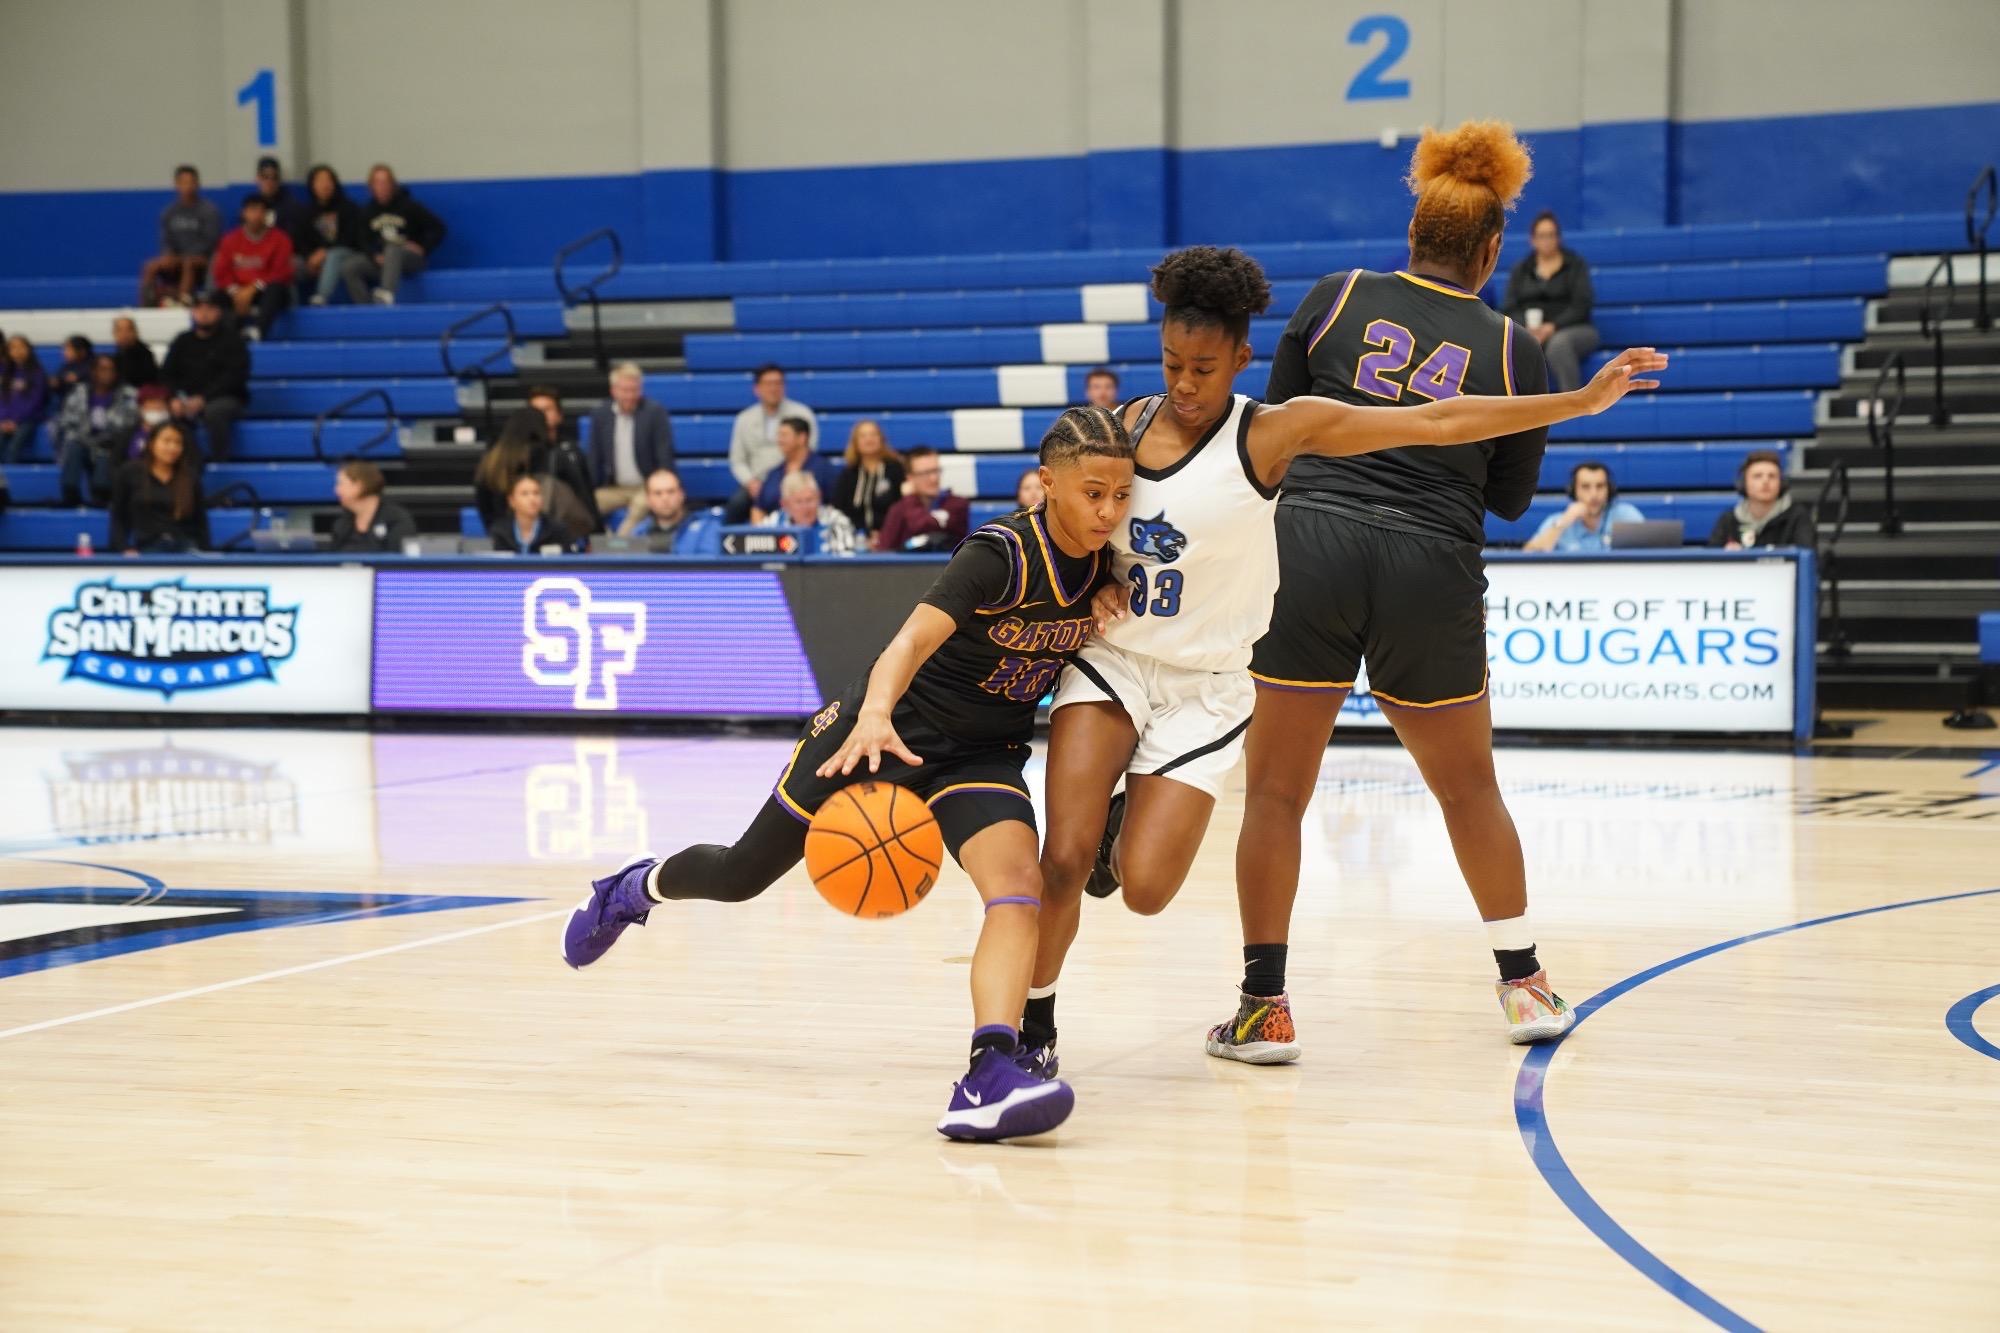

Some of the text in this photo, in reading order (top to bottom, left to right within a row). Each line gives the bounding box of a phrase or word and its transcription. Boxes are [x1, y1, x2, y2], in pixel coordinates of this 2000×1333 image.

[1345, 14, 1411, 101] 2
[237, 69, 276, 146] 1
[1353, 318, 1471, 402] 24
[80, 585, 267, 617] CAL STATE
[1485, 596, 1600, 621] HOME
[1613, 599, 1665, 621] OF
[1676, 599, 1756, 621] THE
[48, 611, 296, 658] SAN MARCOS
[523, 577, 648, 710] SF
[1486, 628, 1780, 666] OUGARS
[82, 655, 257, 685] COUGARS
[977, 656, 1065, 702] 10
